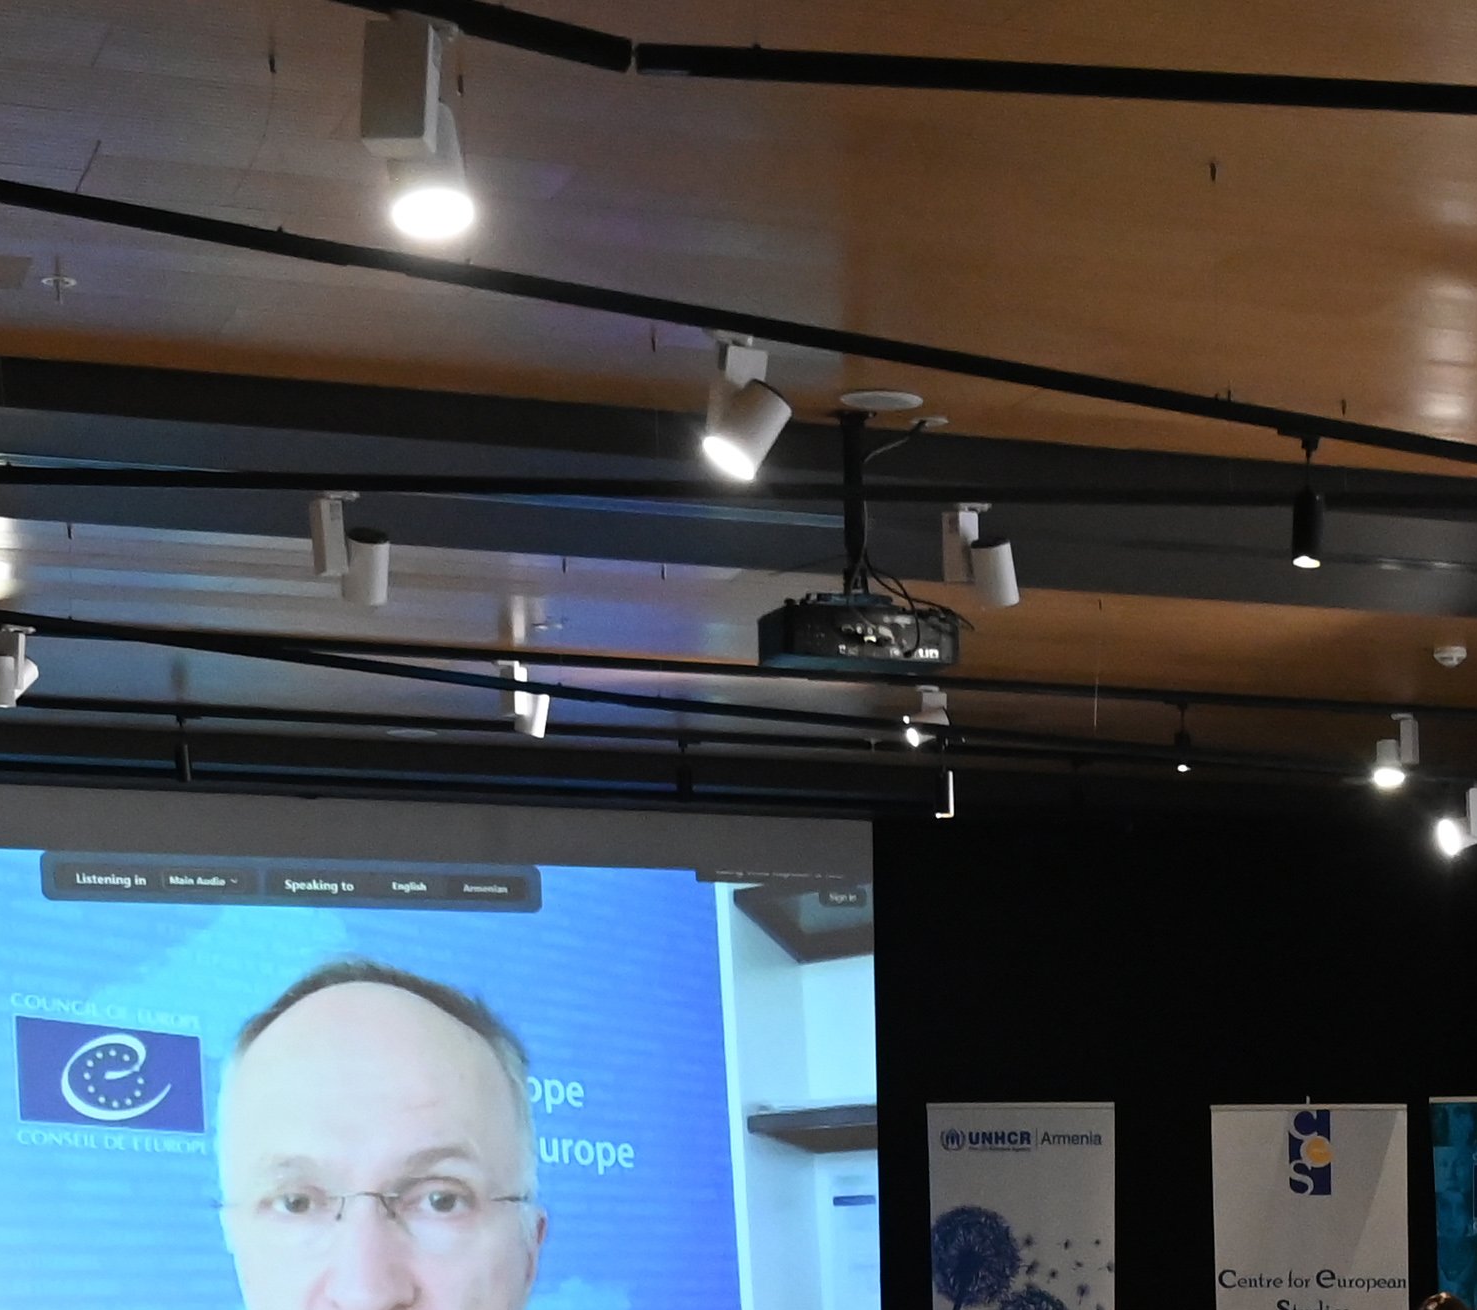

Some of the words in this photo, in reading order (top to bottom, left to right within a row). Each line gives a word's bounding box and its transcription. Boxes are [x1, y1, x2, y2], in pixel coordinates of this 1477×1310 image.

[75, 872, 131, 888] Listening
[134, 874, 147, 886] in
[169, 876, 194, 886] Main
[196, 877, 226, 887] Audio
[284, 878, 337, 895] Speaking
[339, 881, 355, 892] to
[392, 881, 427, 893] English
[10, 992, 97, 1016] COUNCIL
[527, 1076, 584, 1114] ope
[17, 1129, 96, 1149] CONSEIL
[968, 1131, 1031, 1145] UNHCR
[1041, 1131, 1102, 1145] Armenia
[539, 1136, 635, 1175] urope
[1218, 1269, 1283, 1289] Centre
[1287, 1269, 1311, 1289] for
